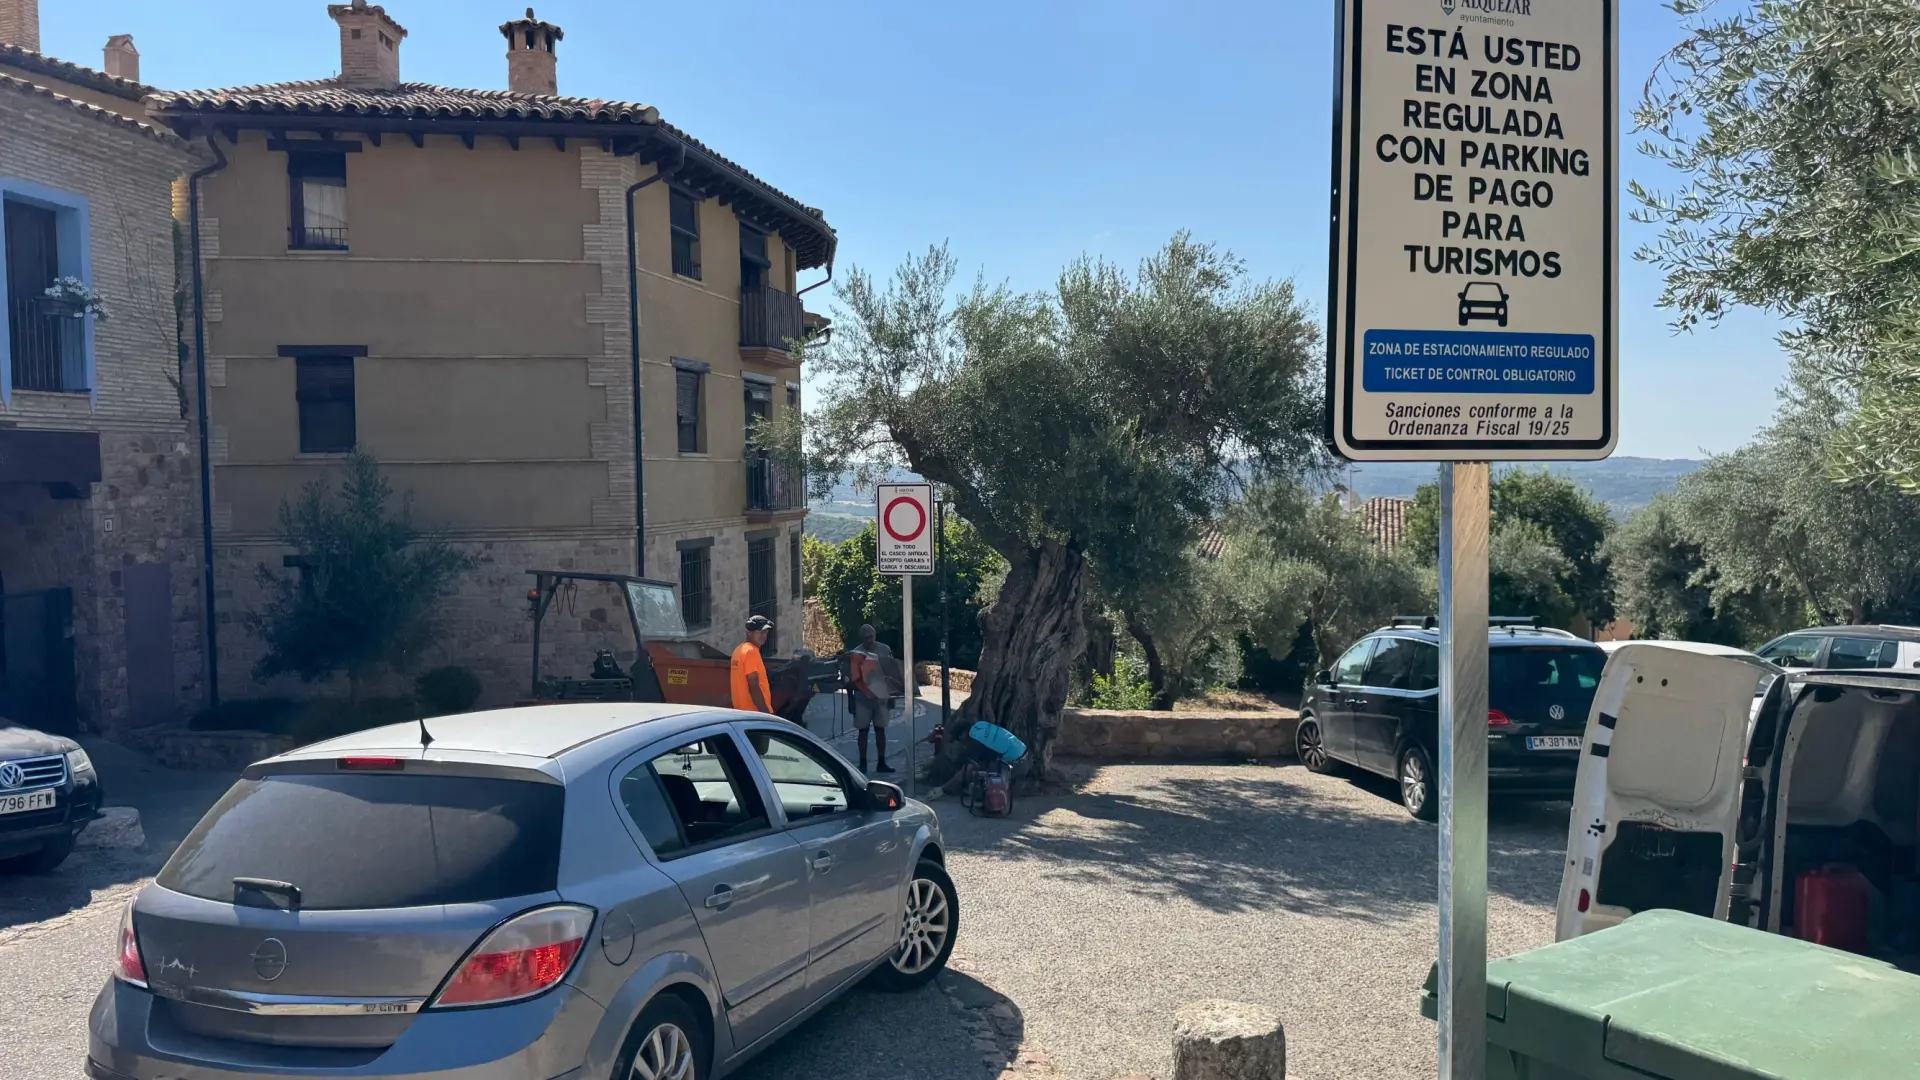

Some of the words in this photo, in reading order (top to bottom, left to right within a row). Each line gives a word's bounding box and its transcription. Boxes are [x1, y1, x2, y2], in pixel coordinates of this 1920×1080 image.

[1460, 13, 1515, 27] ayuntamiento
[1387, 24, 1468, 60] ESTÁ
[1485, 35, 1580, 71] USTED
[1416, 64, 1455, 94] EN
[1471, 70, 1552, 104] ZONA
[1404, 100, 1564, 139] REGULADA
[1376, 134, 1445, 165] CON
[1461, 141, 1589, 176] PARKING
[1415, 173, 1453, 202] DE
[1469, 177, 1553, 208] PAGO
[1443, 211, 1525, 241] PARA
[1404, 245, 1561, 278] TURISMOS
[1370, 342, 1402, 355] ZONA
[1405, 343, 1420, 355] DE
[1423, 343, 1528, 358] ESTACIONAMIENTO
[1531, 346, 1590, 359] REGULADO
[1385, 367, 1425, 380] TICKET
[1428, 368, 1443, 380] DE
[1446, 368, 1500, 381] CONTROL
[1503, 369, 1576, 382] OBLIGATORIO
[1386, 402, 1461, 418] Sanciones
[1469, 403, 1537, 418] conforme
[1545, 406, 1553, 418] a
[1561, 403, 1574, 418] la
[1388, 420, 1468, 436] Ordenanza
[1477, 420, 1520, 436] Fiscal
[1528, 420, 1570, 436] 19/25
[29, 793, 52, 809] FFW
